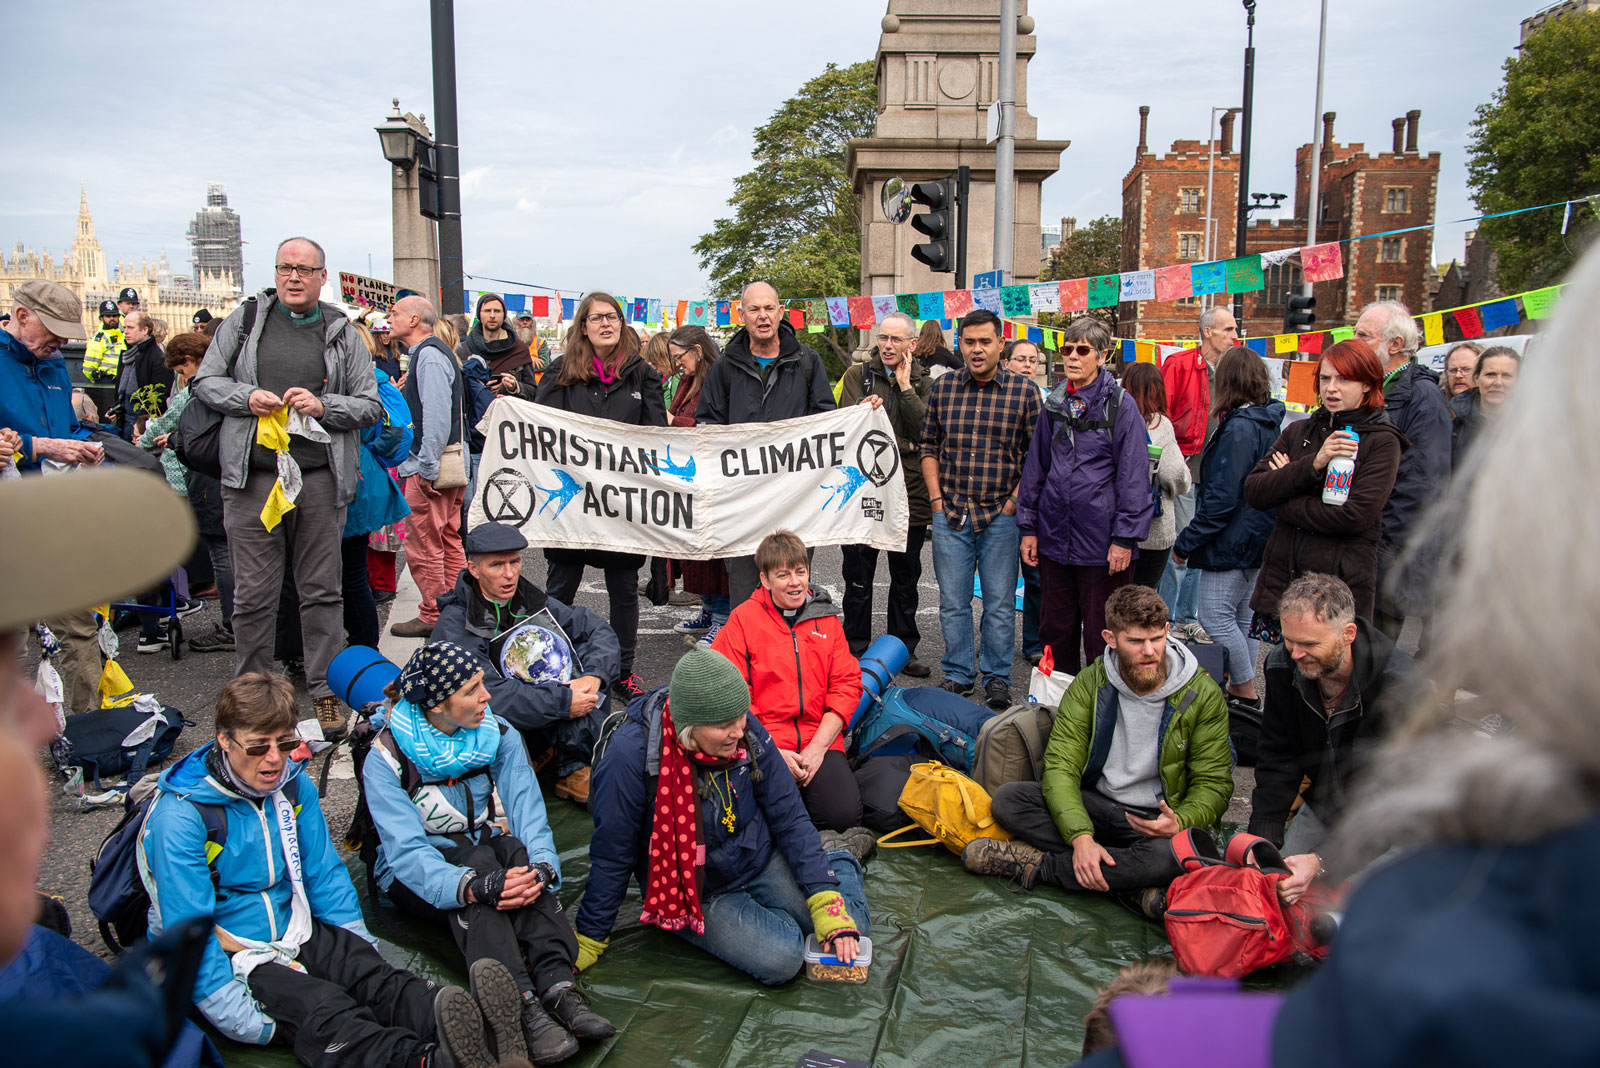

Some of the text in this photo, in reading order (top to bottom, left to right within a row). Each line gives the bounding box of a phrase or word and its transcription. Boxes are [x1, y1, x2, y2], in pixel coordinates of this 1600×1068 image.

[341, 273, 395, 293] NO PLANET
[342, 285, 395, 306] NO FUTURE
[498, 420, 845, 477] CHRISTIAN CLIMATE
[583, 481, 694, 529] ACTION
